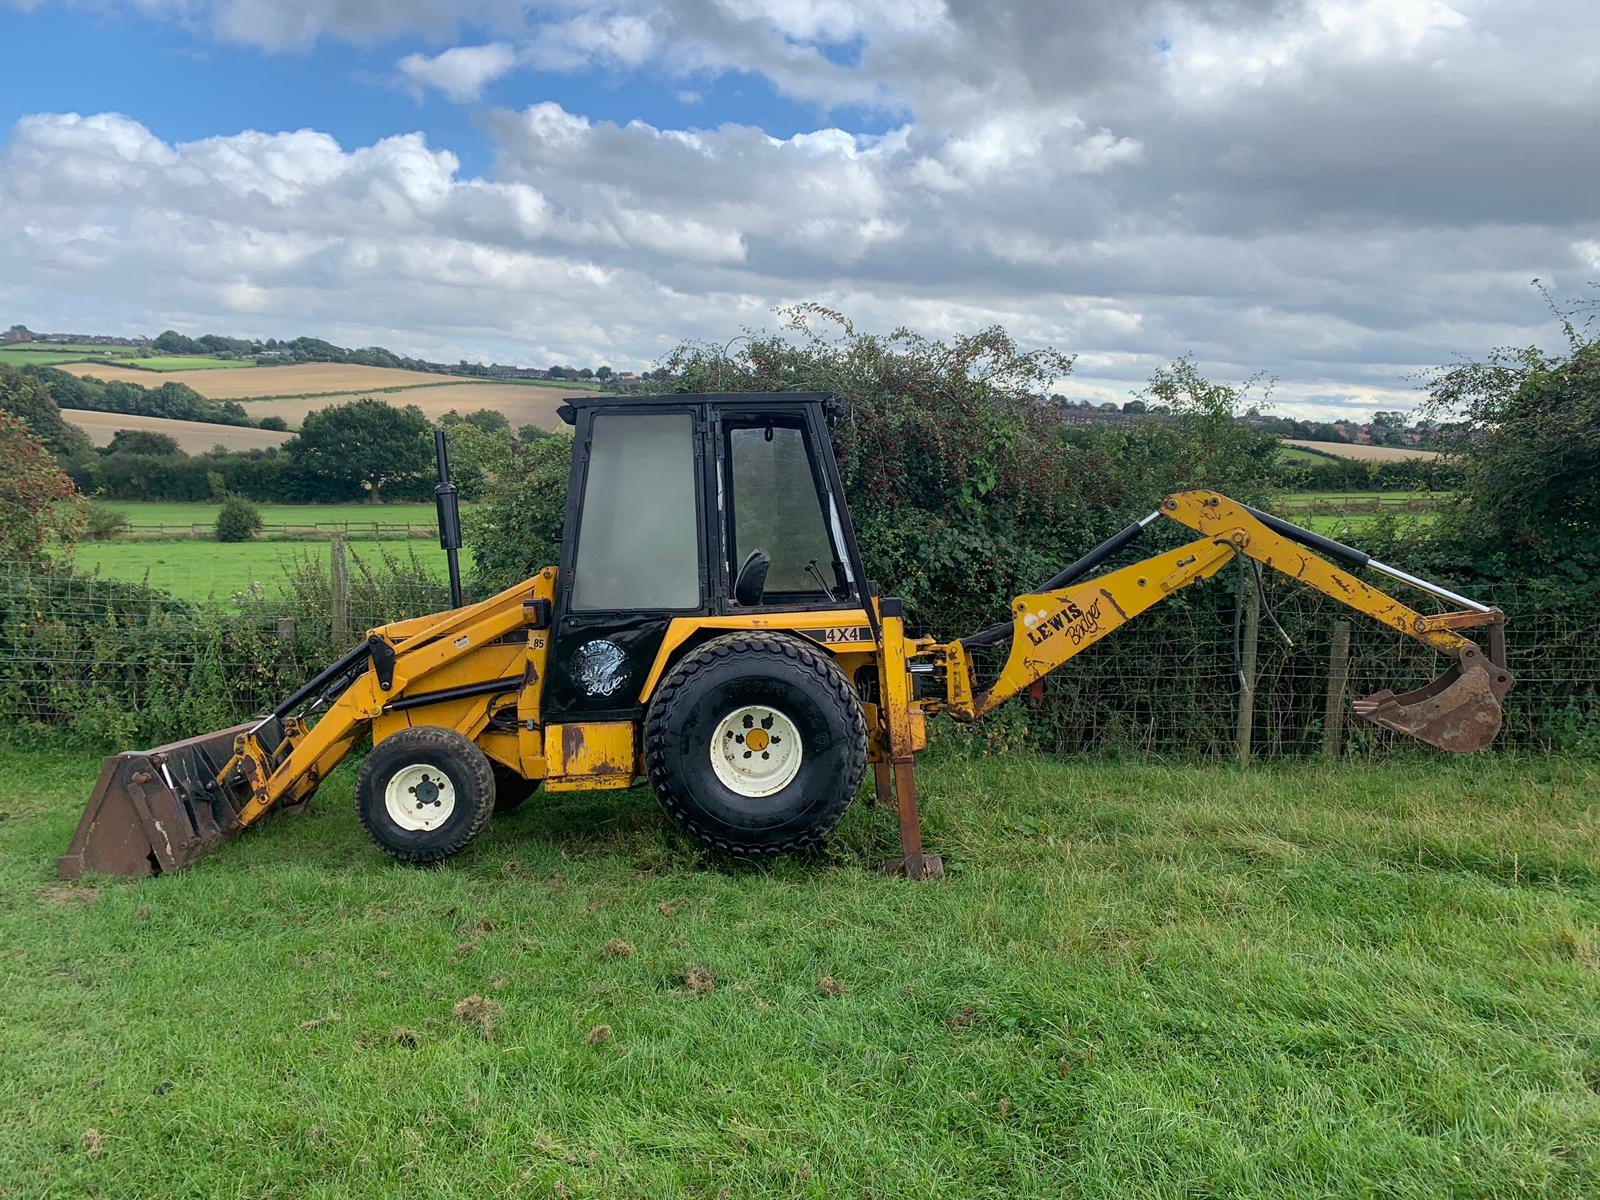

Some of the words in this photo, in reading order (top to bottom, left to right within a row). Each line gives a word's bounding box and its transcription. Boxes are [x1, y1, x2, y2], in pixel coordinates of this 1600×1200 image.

[827, 628, 858, 641] 4X4
[1027, 603, 1082, 646] LEWIS
[1065, 598, 1101, 645] Badger
[534, 638, 544, 648] 85
